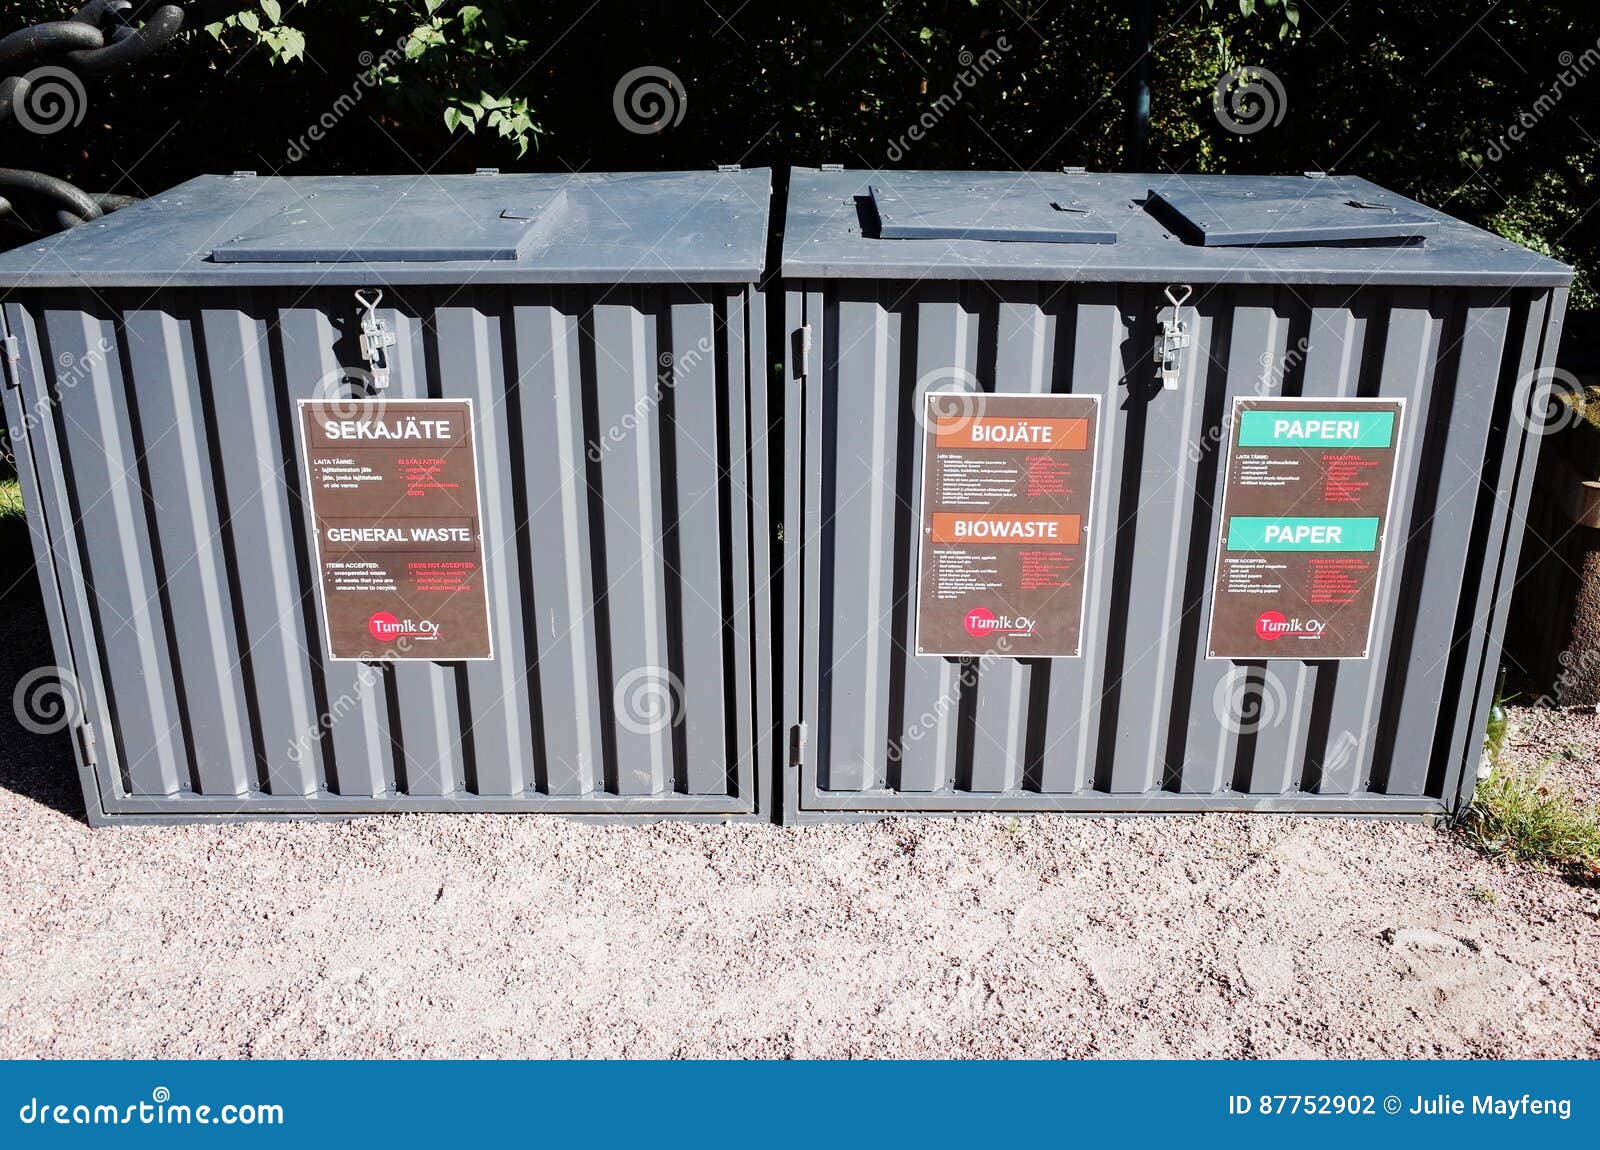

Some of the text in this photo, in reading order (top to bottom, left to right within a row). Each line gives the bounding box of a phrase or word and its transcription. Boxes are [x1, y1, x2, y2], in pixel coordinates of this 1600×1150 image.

[325, 416, 451, 439] SEKAJÄTE
[972, 422, 1052, 442] BIOJÄTE
[1274, 420, 1360, 439] PAPERI
[327, 528, 470, 542] GENERAL WASTE
[954, 520, 1058, 537] BIOWASTE
[1264, 526, 1342, 544] PAPER
[374, 619, 439, 636] Tumik Oy
[969, 616, 1035, 632] Tumik Oy
[1260, 619, 1325, 635] Tumik Oy
